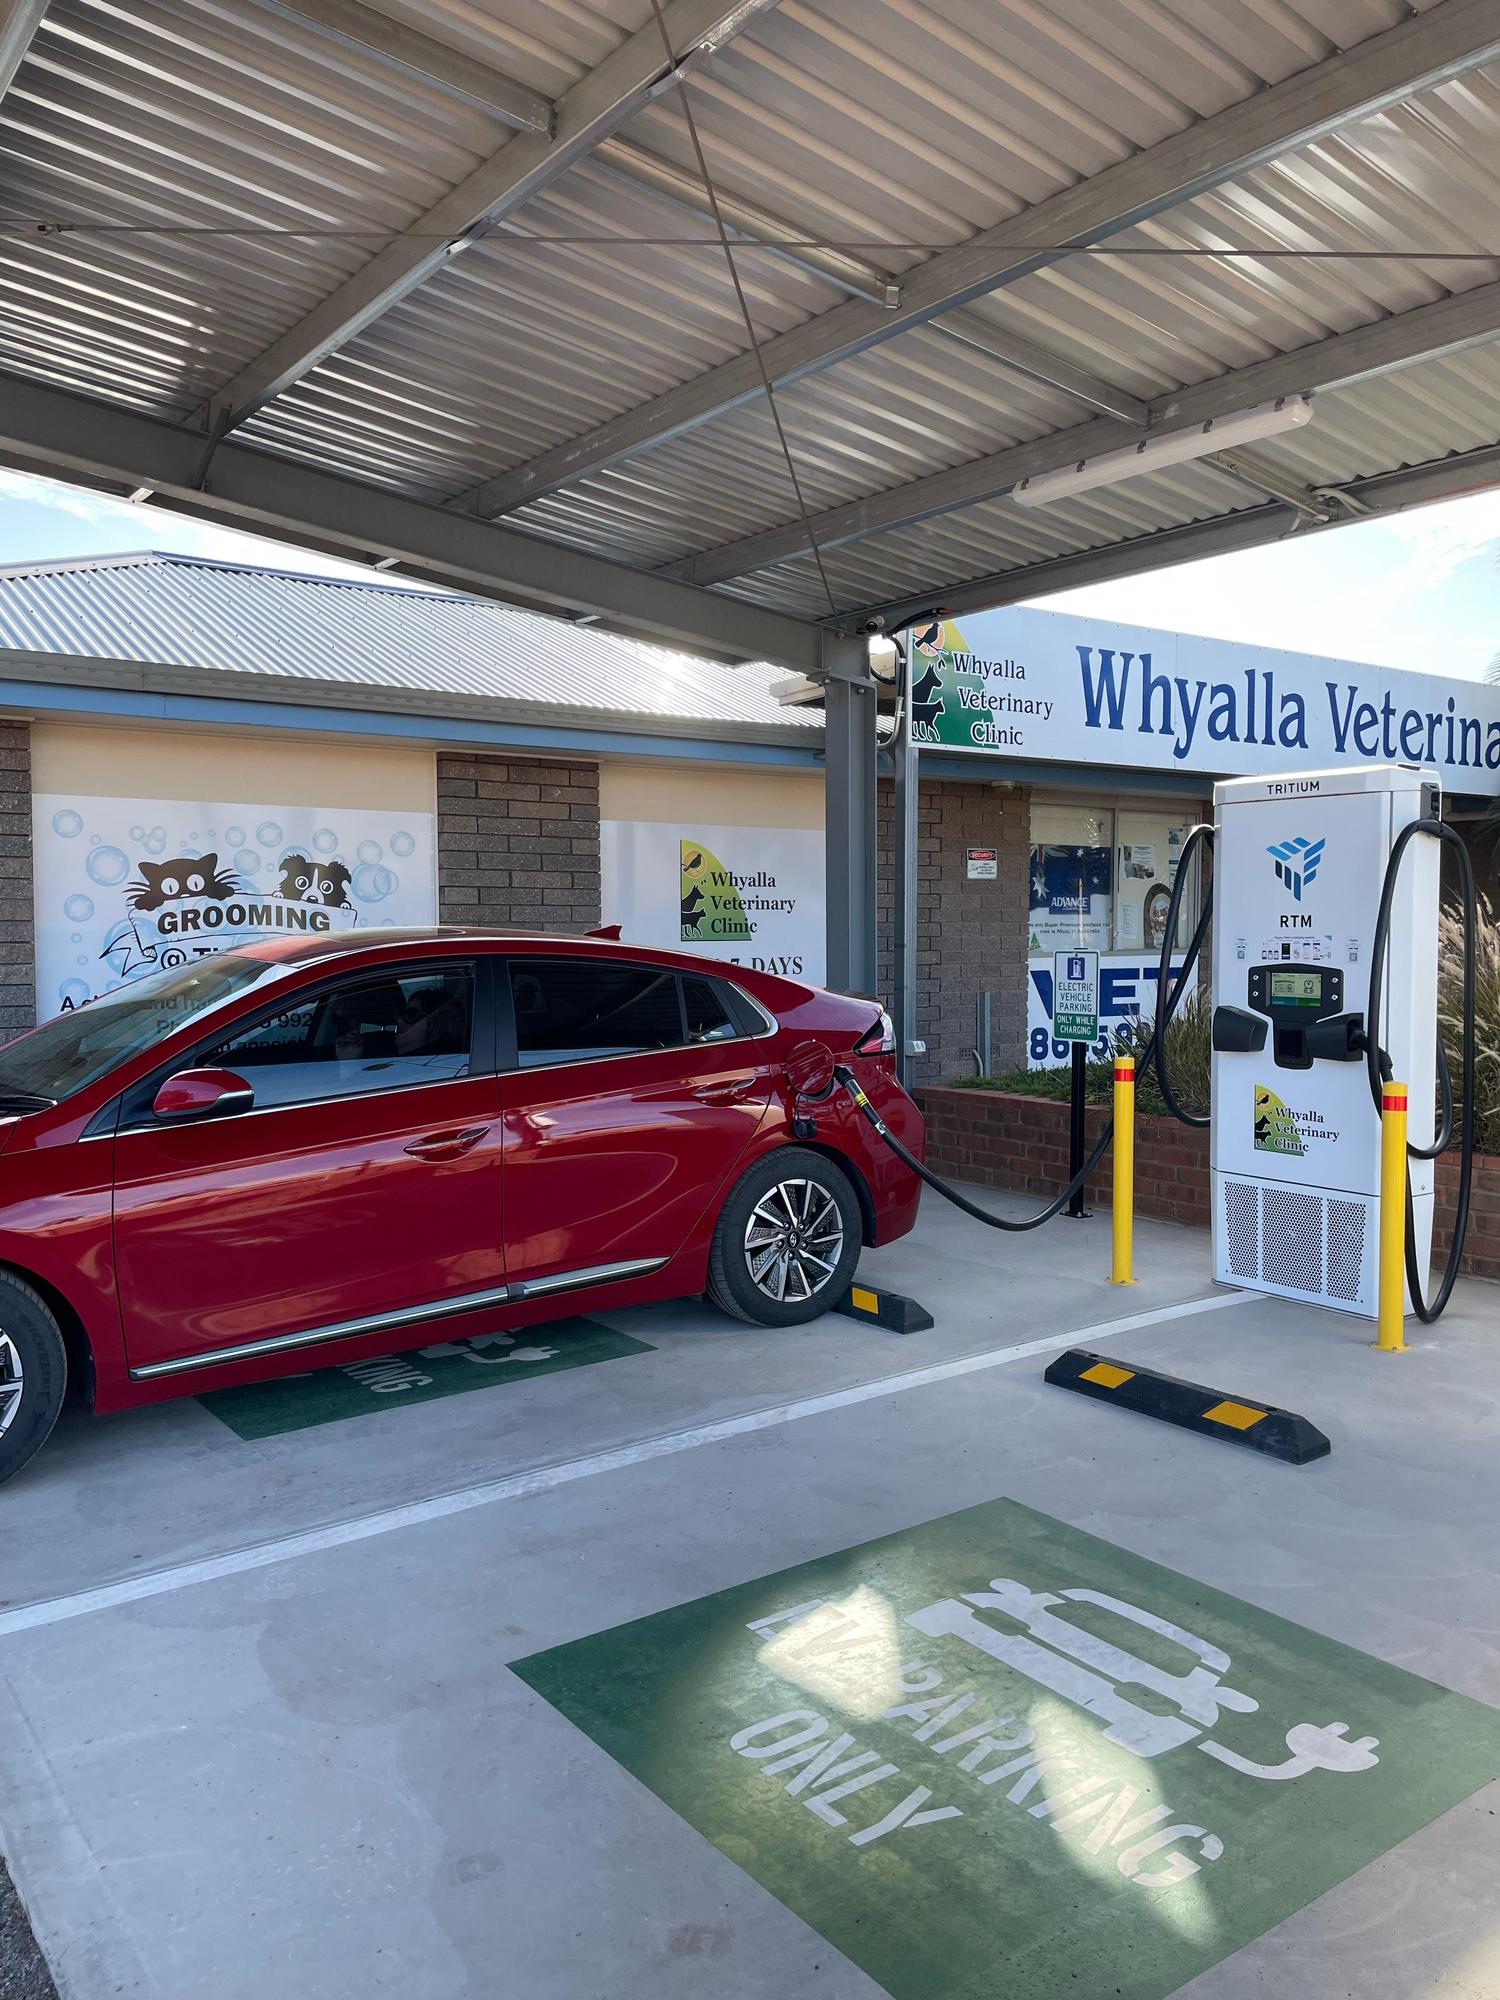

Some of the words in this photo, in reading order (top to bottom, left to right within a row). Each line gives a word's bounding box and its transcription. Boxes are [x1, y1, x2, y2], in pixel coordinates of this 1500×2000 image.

[953, 653, 1026, 680] Whyalla
[958, 688, 1054, 721] Veterinary
[1075, 645, 1308, 760] Whyalla
[1325, 682, 1500, 769] Veterina
[972, 722, 1024, 746] Clinic
[1266, 781, 1320, 795] TRITIUM
[710, 871, 776, 890] Whyalla
[710, 895, 796, 914] Veterinary
[1051, 896, 1088, 907] ADVANCE
[157, 904, 330, 935] GROOMING
[710, 918, 758, 934] Clinic
[1279, 914, 1312, 929] RTM
[751, 957, 803, 975] DAYS
[1058, 982, 1094, 992] ELECTRIC
[1061, 993, 1092, 1002] VEHICLE
[1059, 1002, 1093, 1013] PARKING
[1057, 1015, 1072, 1024] ONLY
[1076, 1016, 1095, 1025] WHILE
[1060, 1025, 1091, 1035] CHARGING
[1275, 1107, 1324, 1123] Whyalla
[1275, 1123, 1340, 1142] Veterinary
[1275, 1138, 1309, 1152] Clinic
[730, 1709, 963, 1846] ONLY
[850, 1659, 1224, 1887] PARKING
